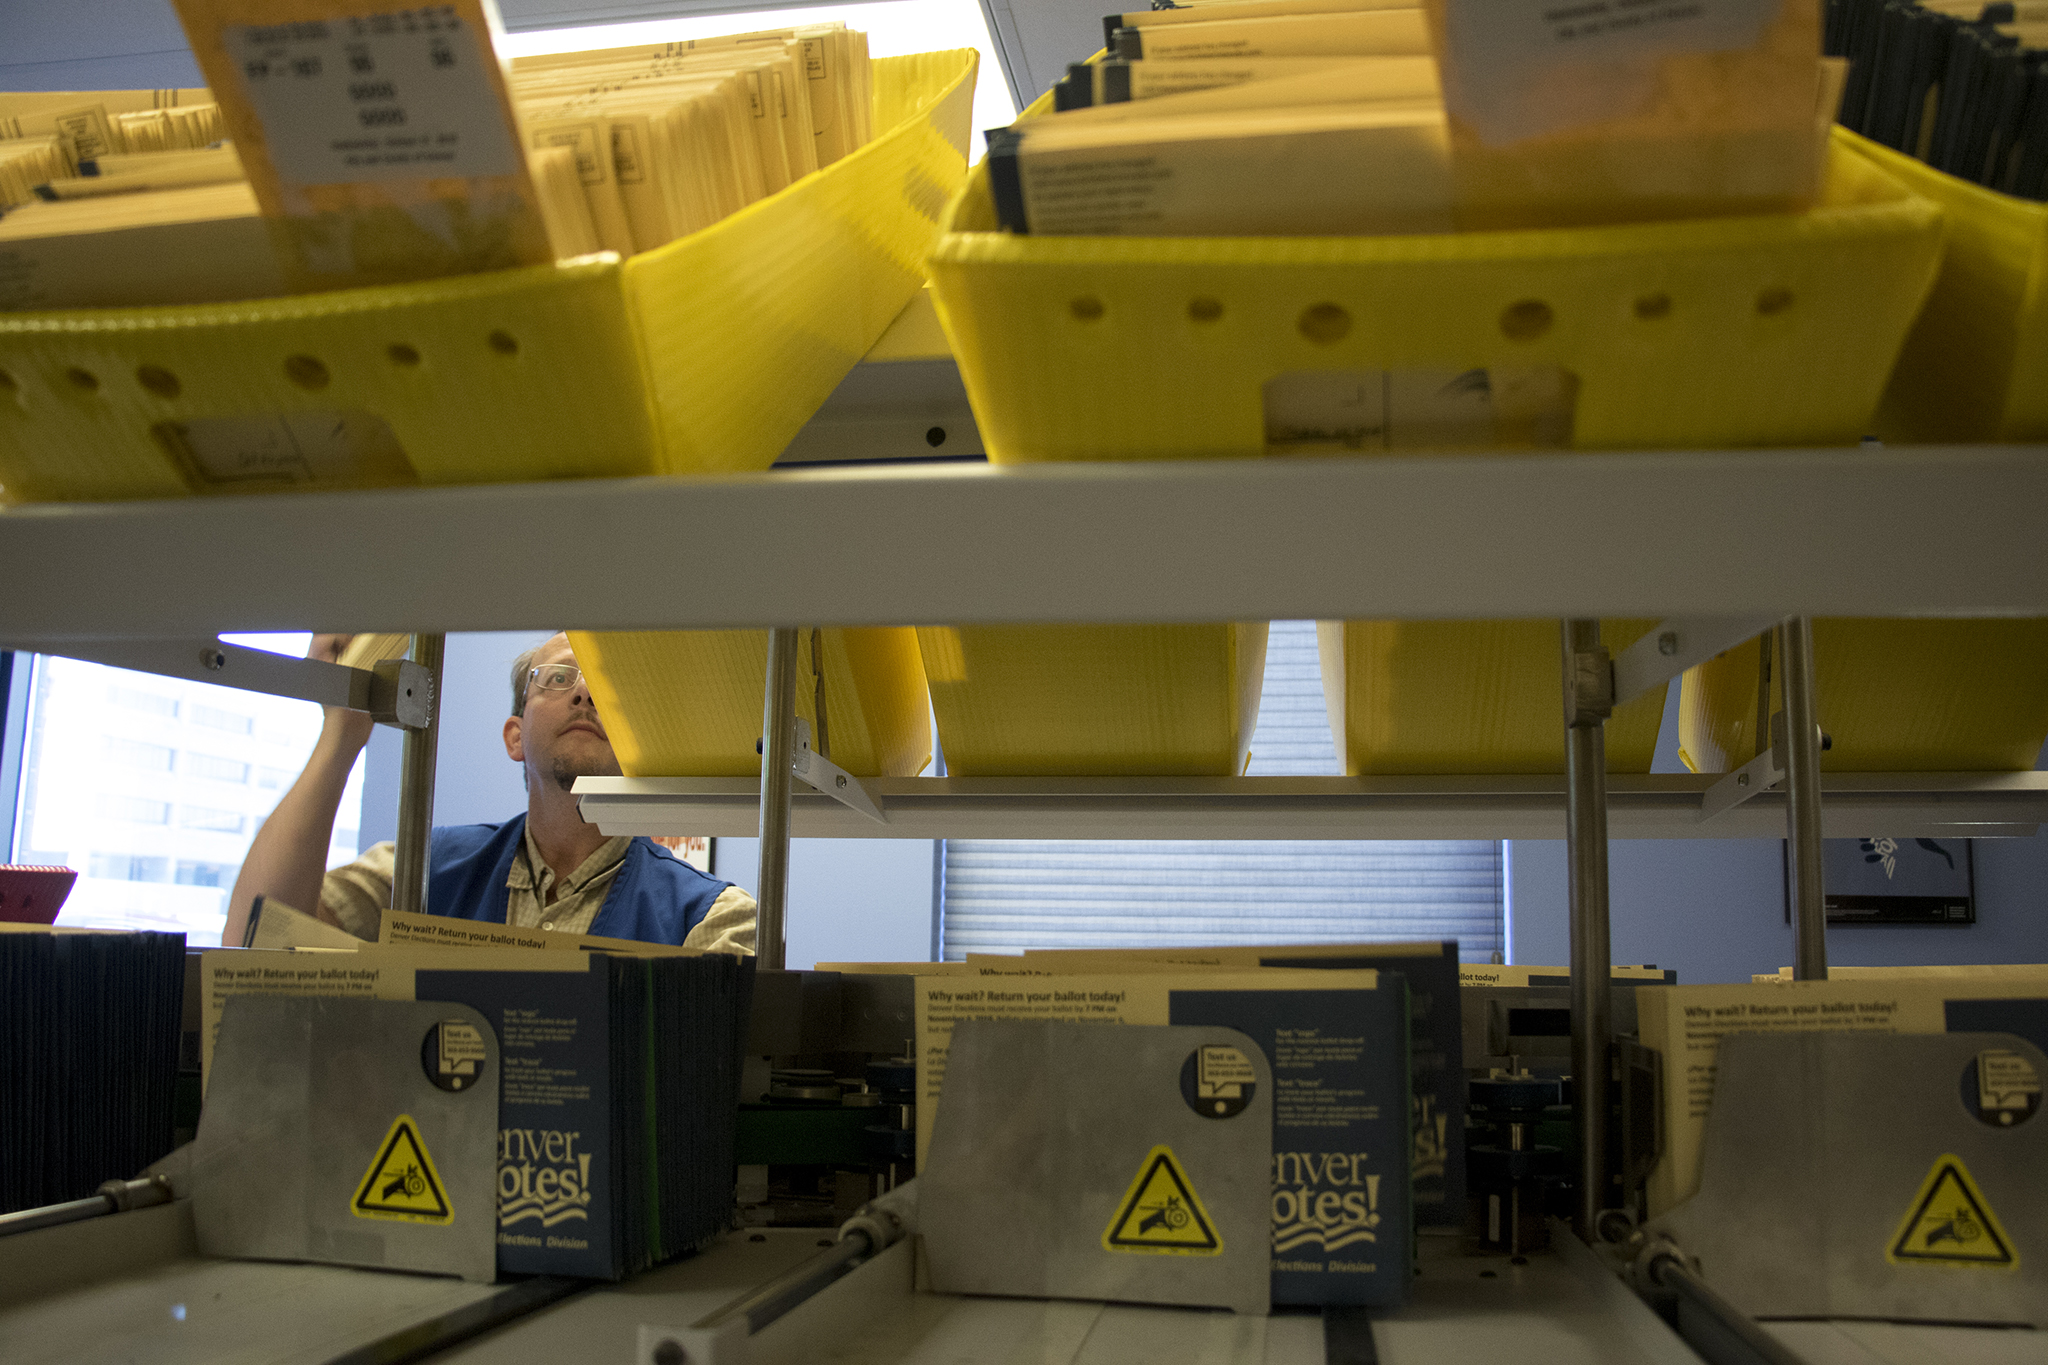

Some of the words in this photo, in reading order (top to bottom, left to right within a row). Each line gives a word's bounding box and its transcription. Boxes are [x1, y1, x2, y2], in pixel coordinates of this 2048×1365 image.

[391, 920, 412, 934] Why
[413, 924, 437, 936] wait?
[438, 927, 467, 940] Return
[469, 932, 489, 943] your
[490, 933, 515, 947] ballot
[517, 938, 547, 950] today!
[213, 967, 235, 981] Why
[236, 967, 263, 980] wait?
[264, 969, 296, 980] Return
[297, 971, 319, 982] your
[320, 968, 348, 980] ballot
[348, 969, 380, 982] today!
[1459, 972, 1474, 981] llot
[1475, 974, 1499, 982] today!
[927, 989, 953, 1004] Why
[954, 989, 985, 1002] wait?
[987, 990, 1024, 1002] Return
[1026, 992, 1052, 1004] your
[1054, 989, 1087, 1002] ballot
[1088, 990, 1126, 1004] today!
[1684, 1006, 1711, 1018] Why
[1714, 1004, 1747, 1016] wait?
[1749, 1003, 1789, 1015] Return
[1792, 1003, 1819, 1015] your
[1820, 1001, 1855, 1014] ballot
[1857, 1000, 1898, 1013] today!
[499, 1127, 581, 1165] nver
[498, 1152, 593, 1203] otes!
[1272, 1150, 1369, 1187] nver
[1271, 1173, 1382, 1227] otes!
[546, 1234, 589, 1250] Division
[1327, 1260, 1377, 1274] Division
